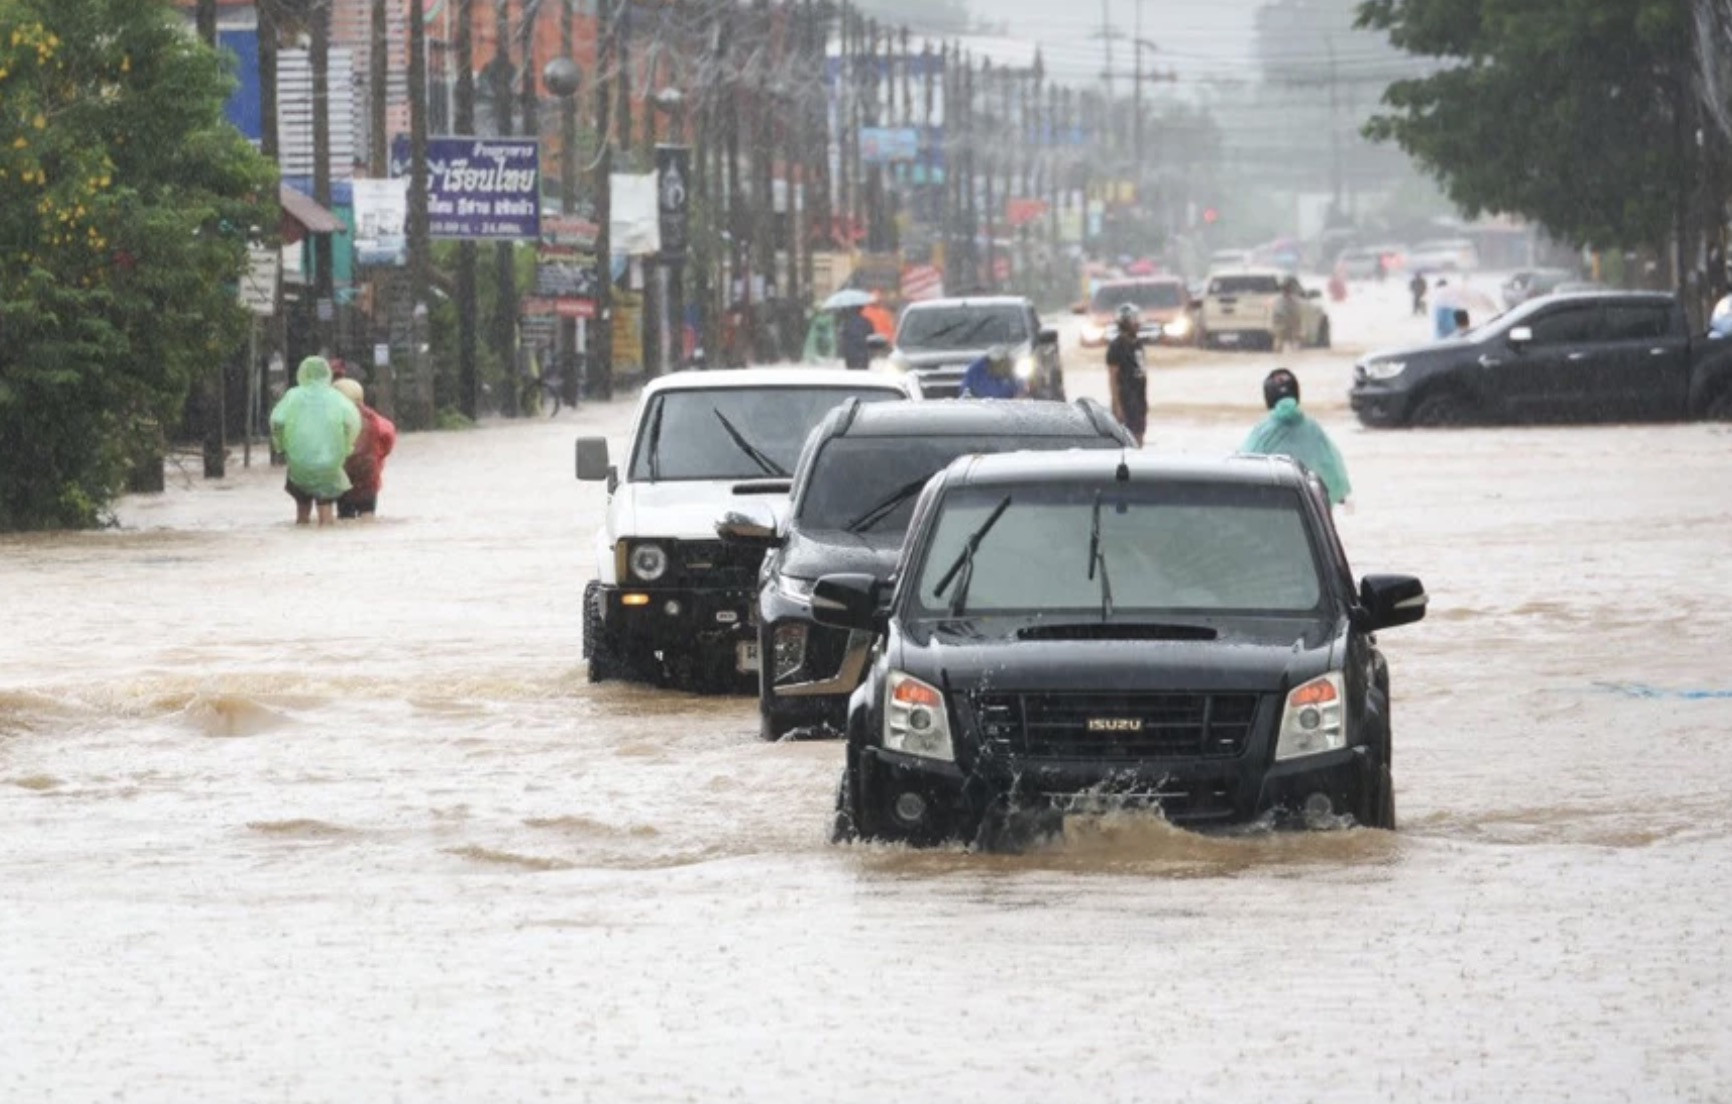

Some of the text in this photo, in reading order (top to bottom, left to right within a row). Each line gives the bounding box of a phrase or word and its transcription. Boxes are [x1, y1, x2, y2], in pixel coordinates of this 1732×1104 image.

[442, 156, 535, 192] เรือนไทย
[1088, 717, 1141, 731] ISUZU
